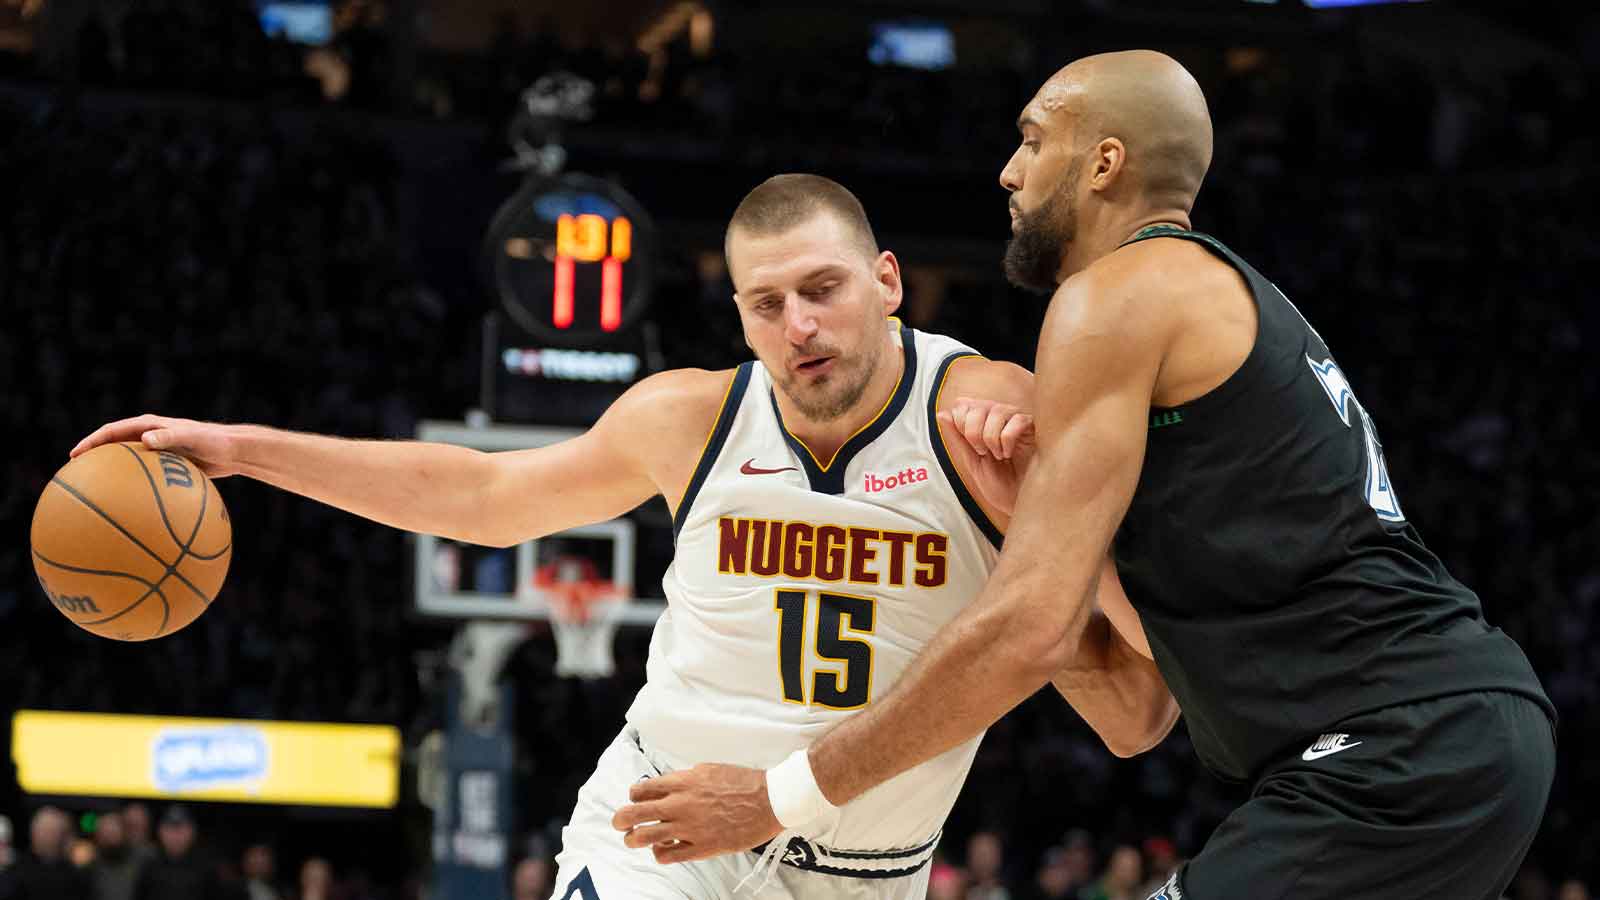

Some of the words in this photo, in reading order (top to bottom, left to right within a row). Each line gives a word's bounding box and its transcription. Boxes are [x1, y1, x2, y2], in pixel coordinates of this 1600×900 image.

[864, 467, 929, 493] ibotta
[718, 517, 949, 590] NUGGETS
[774, 586, 878, 711] 15
[1311, 733, 1350, 750] NIKE
